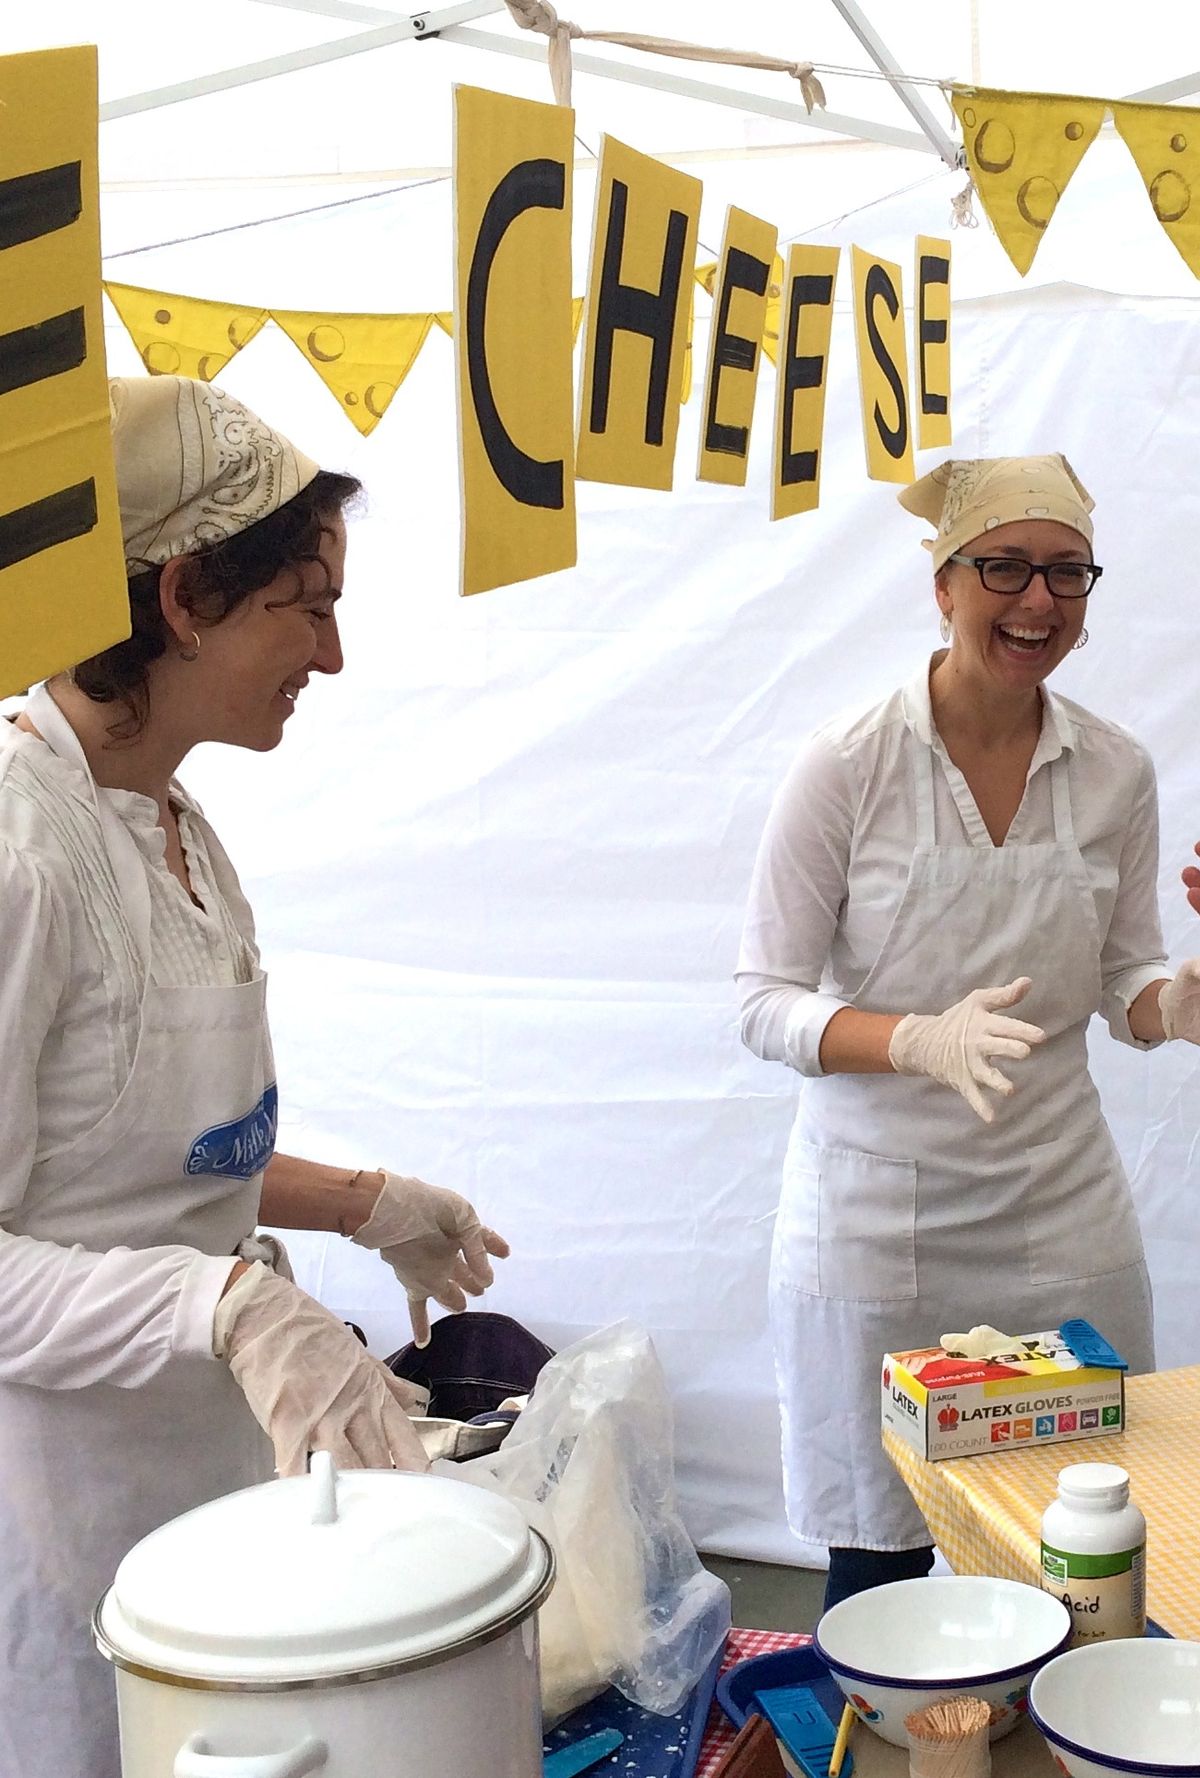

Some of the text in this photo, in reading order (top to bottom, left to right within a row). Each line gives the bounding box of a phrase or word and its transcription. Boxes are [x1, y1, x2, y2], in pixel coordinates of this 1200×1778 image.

[467, 158, 950, 509] CHEESE
[892, 1386, 919, 1420] LATEX
[932, 1392, 958, 1403] LARGE
[961, 1403, 1012, 1422] LATEX
[1014, 1394, 1073, 1415] GLOVES
[929, 1441, 947, 1453] 100
[948, 1436, 988, 1451] COUNT
[1062, 1593, 1100, 1614] Acid
